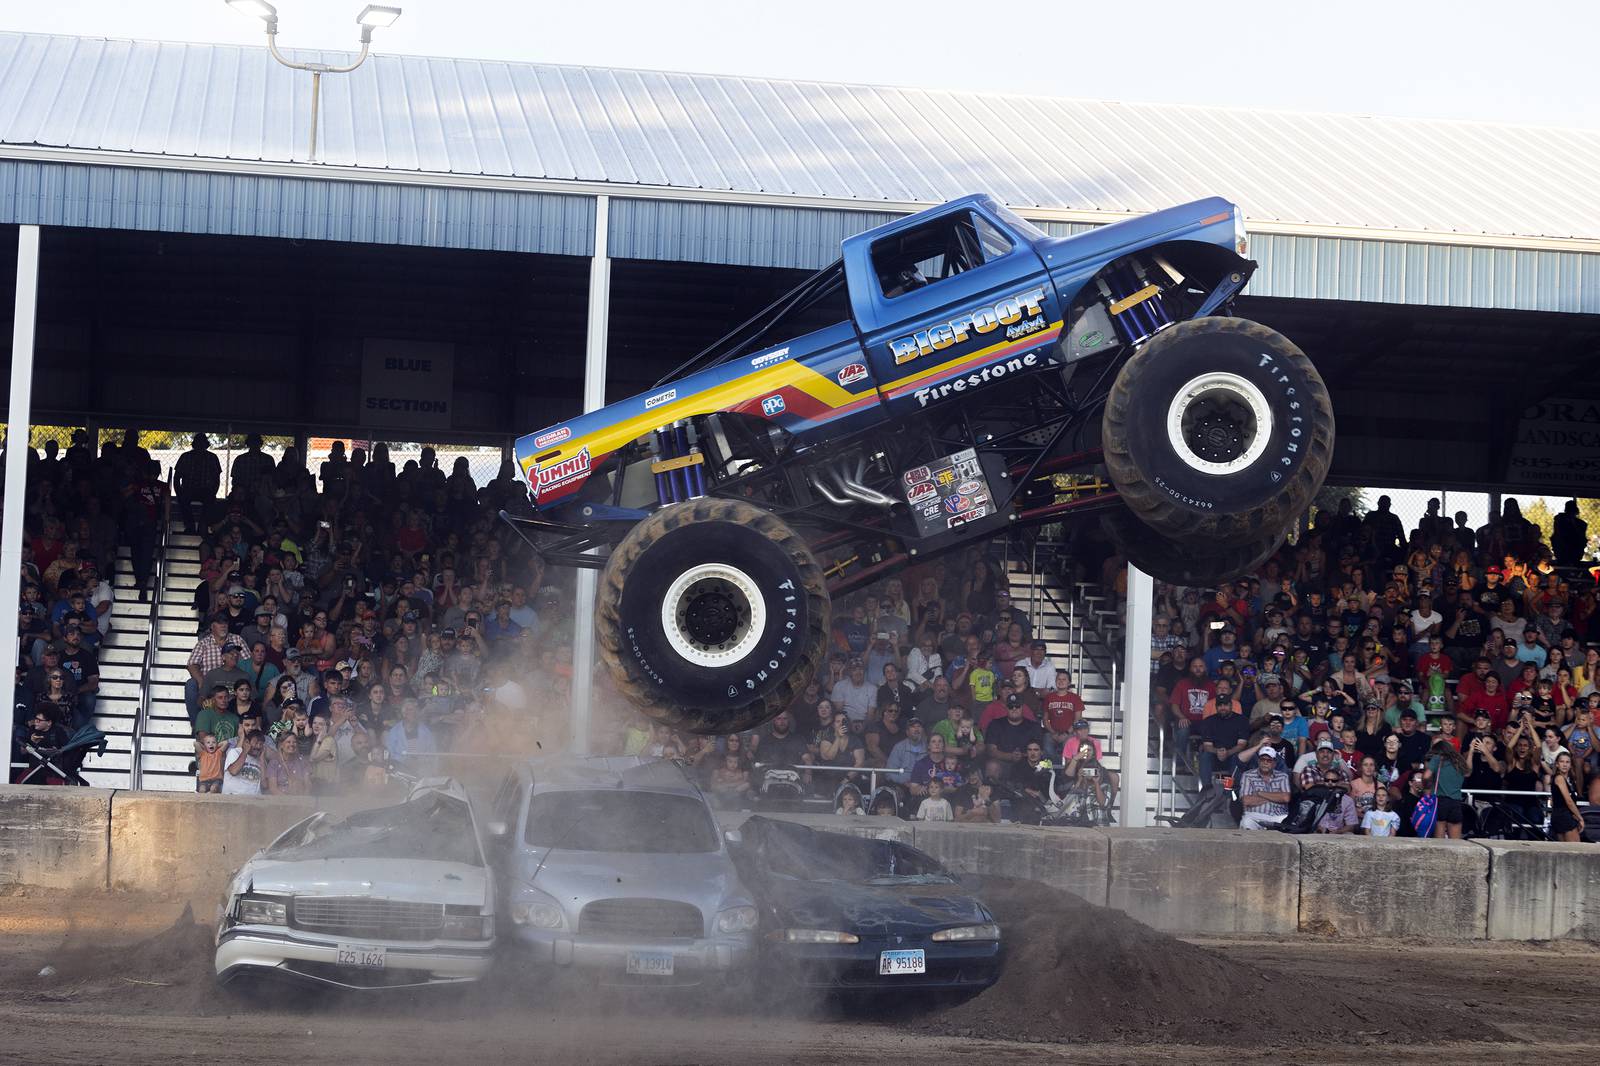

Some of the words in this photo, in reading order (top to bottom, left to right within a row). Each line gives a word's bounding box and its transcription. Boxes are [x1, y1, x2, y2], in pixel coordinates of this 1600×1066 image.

[887, 286, 1046, 365] BIGFOOT
[384, 357, 432, 372] BLUE
[751, 347, 790, 366] ODYSSEY
[754, 354, 789, 369] BATTERY
[838, 364, 866, 380] JAZ
[914, 352, 1038, 408] Firestone
[365, 397, 447, 413] SECTION
[646, 391, 676, 407] COMETIC
[762, 395, 784, 413] PPG
[1258, 352, 1303, 466] Firestone
[541, 483, 562, 494] RACING
[561, 471, 592, 486] EQUIPMENT
[937, 470, 954, 483] BTE
[908, 483, 934, 499] JAZ
[923, 504, 940, 517] CRE
[944, 494, 961, 513] VP
[746, 579, 797, 690] Firestone
[338, 950, 356, 964] E25
[360, 952, 383, 966] 1626
[882, 957, 892, 970] AR
[896, 956, 923, 969] 95188
